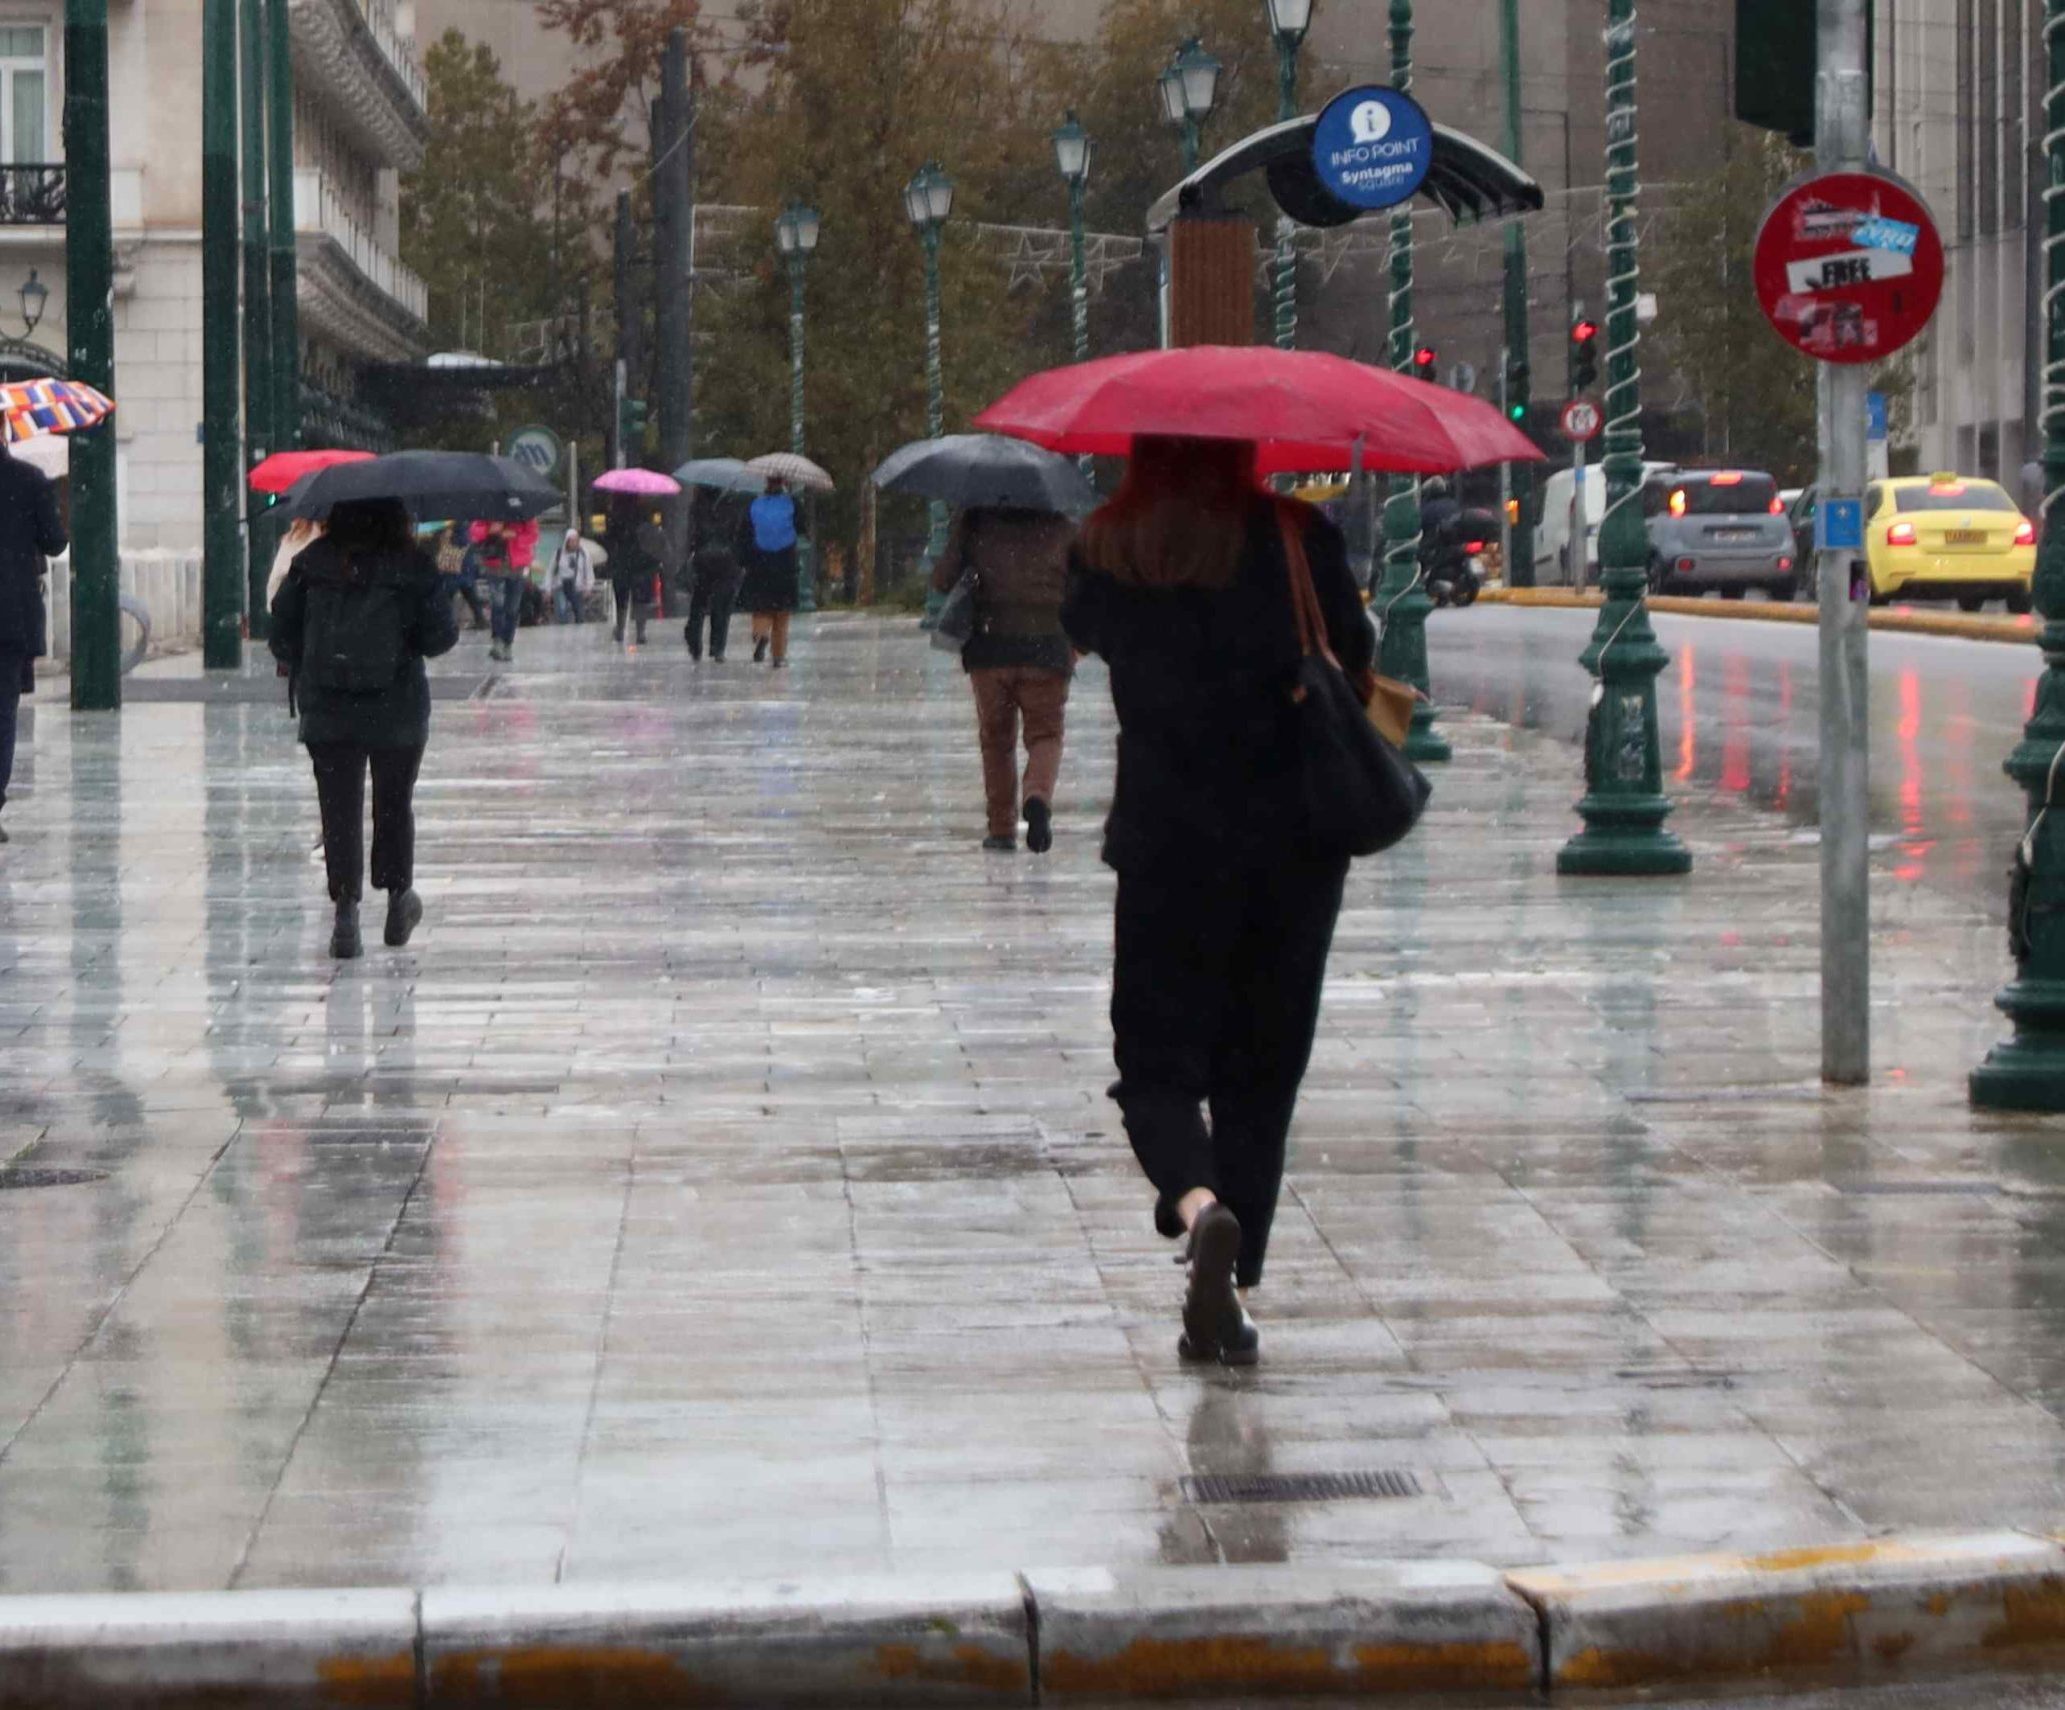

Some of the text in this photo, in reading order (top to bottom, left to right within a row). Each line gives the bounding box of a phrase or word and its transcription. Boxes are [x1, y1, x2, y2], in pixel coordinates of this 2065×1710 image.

[1331, 137, 1419, 168] INFO POINT
[1342, 162, 1413, 184] Syntagma
